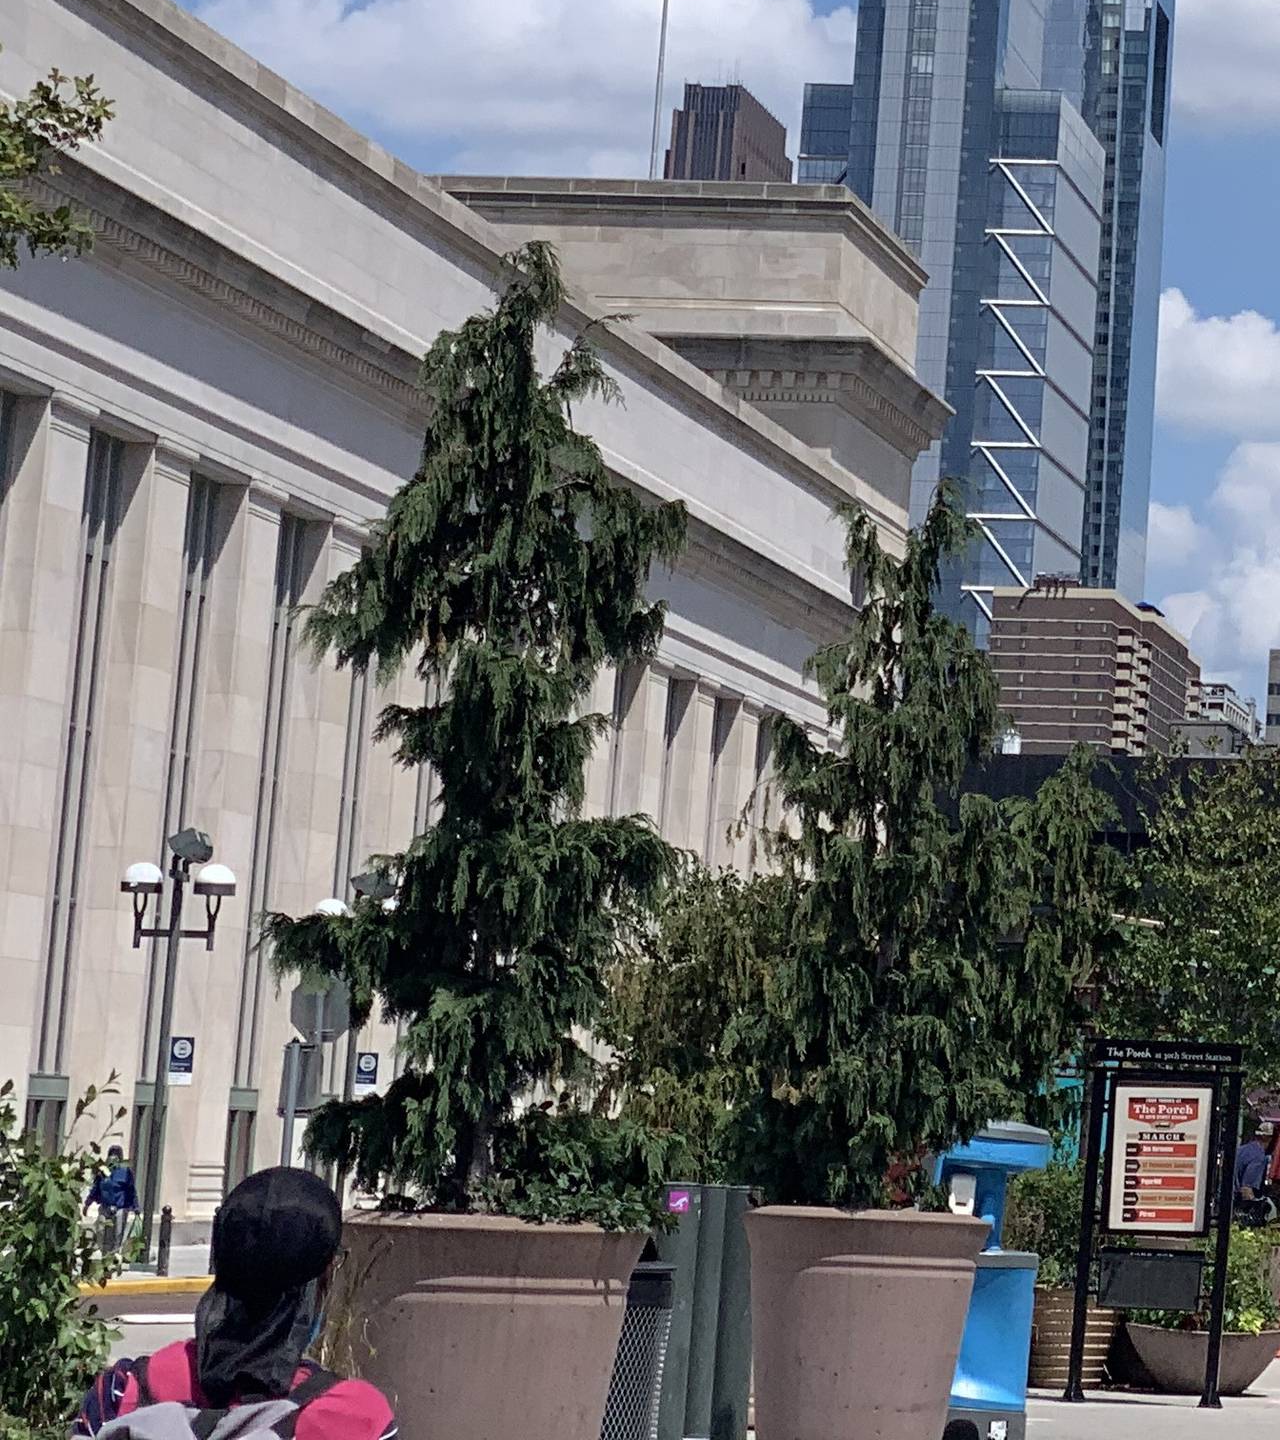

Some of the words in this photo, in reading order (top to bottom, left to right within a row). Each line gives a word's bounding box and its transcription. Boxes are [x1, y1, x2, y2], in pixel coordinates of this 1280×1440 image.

[1106, 1047, 1124, 1058] The
[1125, 1047, 1151, 1058] Porch
[1181, 1052, 1203, 1060] Street
[1205, 1053, 1232, 1061] Station
[1133, 1104, 1156, 1114] The
[1158, 1104, 1193, 1115] Porch
